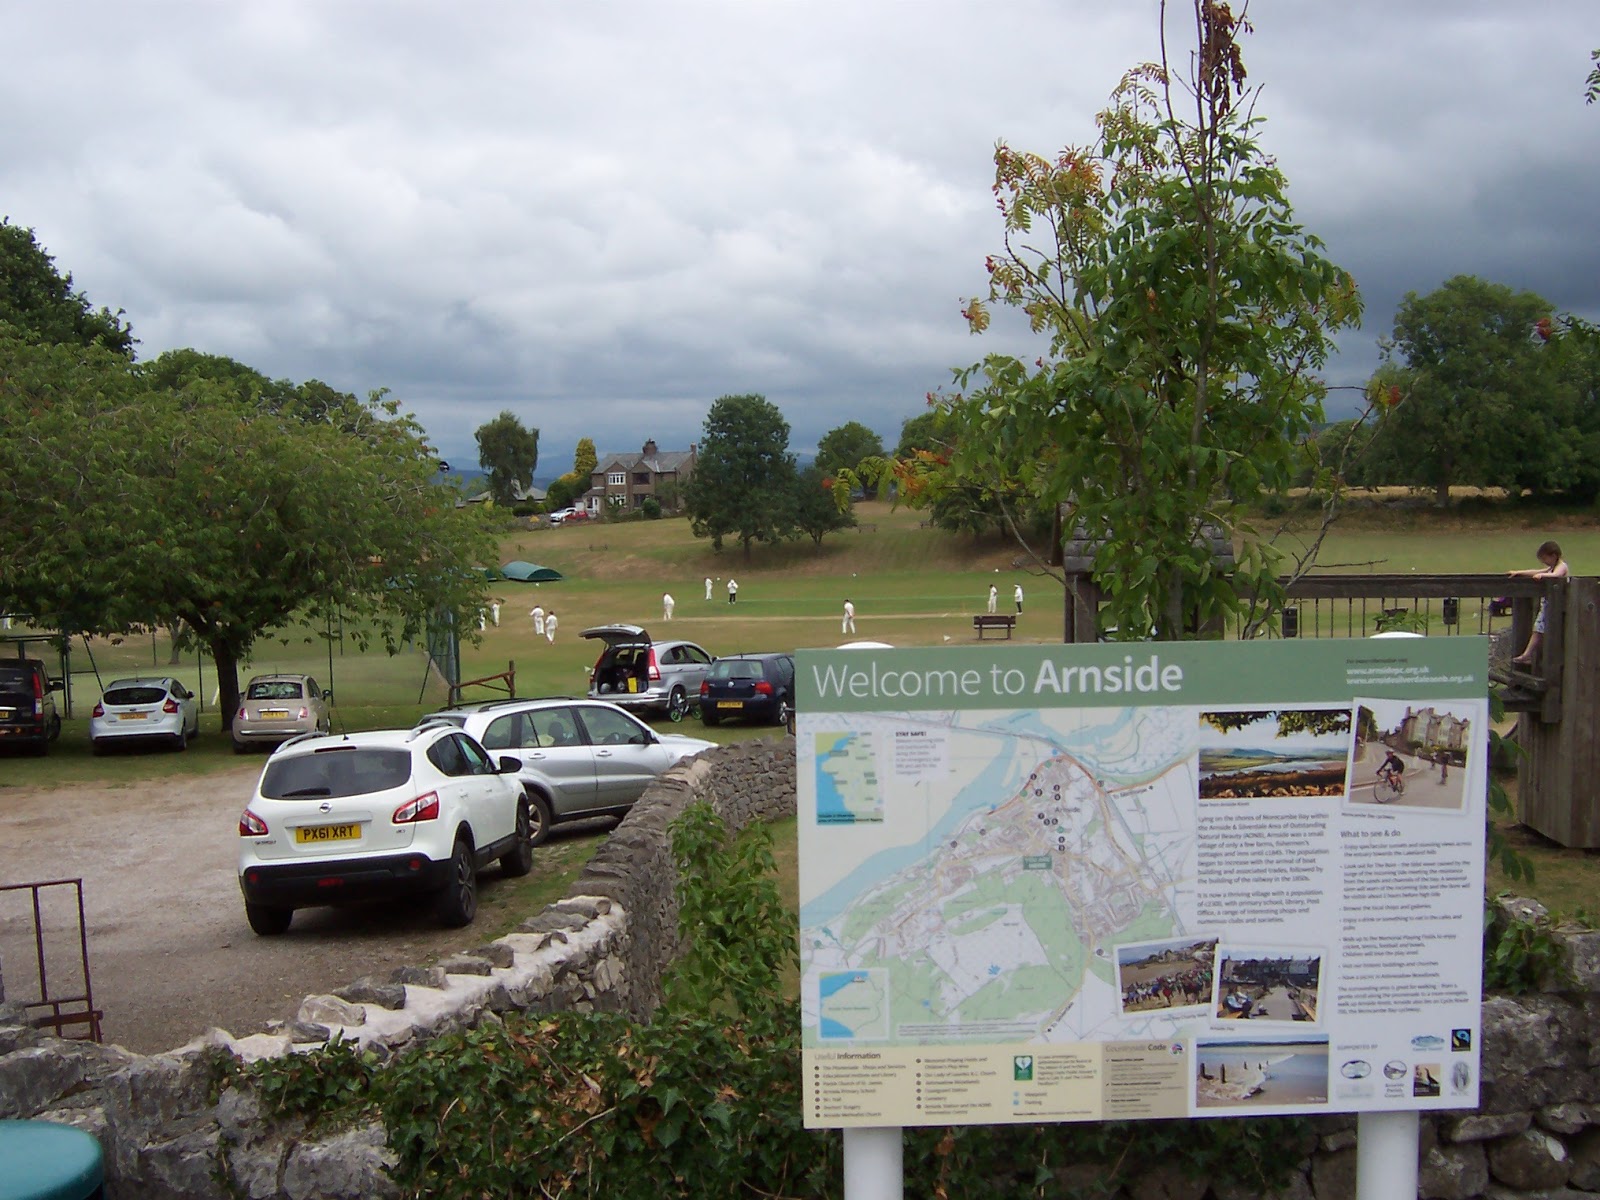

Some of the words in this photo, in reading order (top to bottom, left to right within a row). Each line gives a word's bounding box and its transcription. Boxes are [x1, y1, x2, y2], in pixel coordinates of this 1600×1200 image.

[812, 661, 981, 698] Welcome
[989, 663, 1025, 695] to
[1034, 655, 1183, 694] Arnside
[304, 828, 329, 840] PX61
[332, 825, 354, 838] XRT
